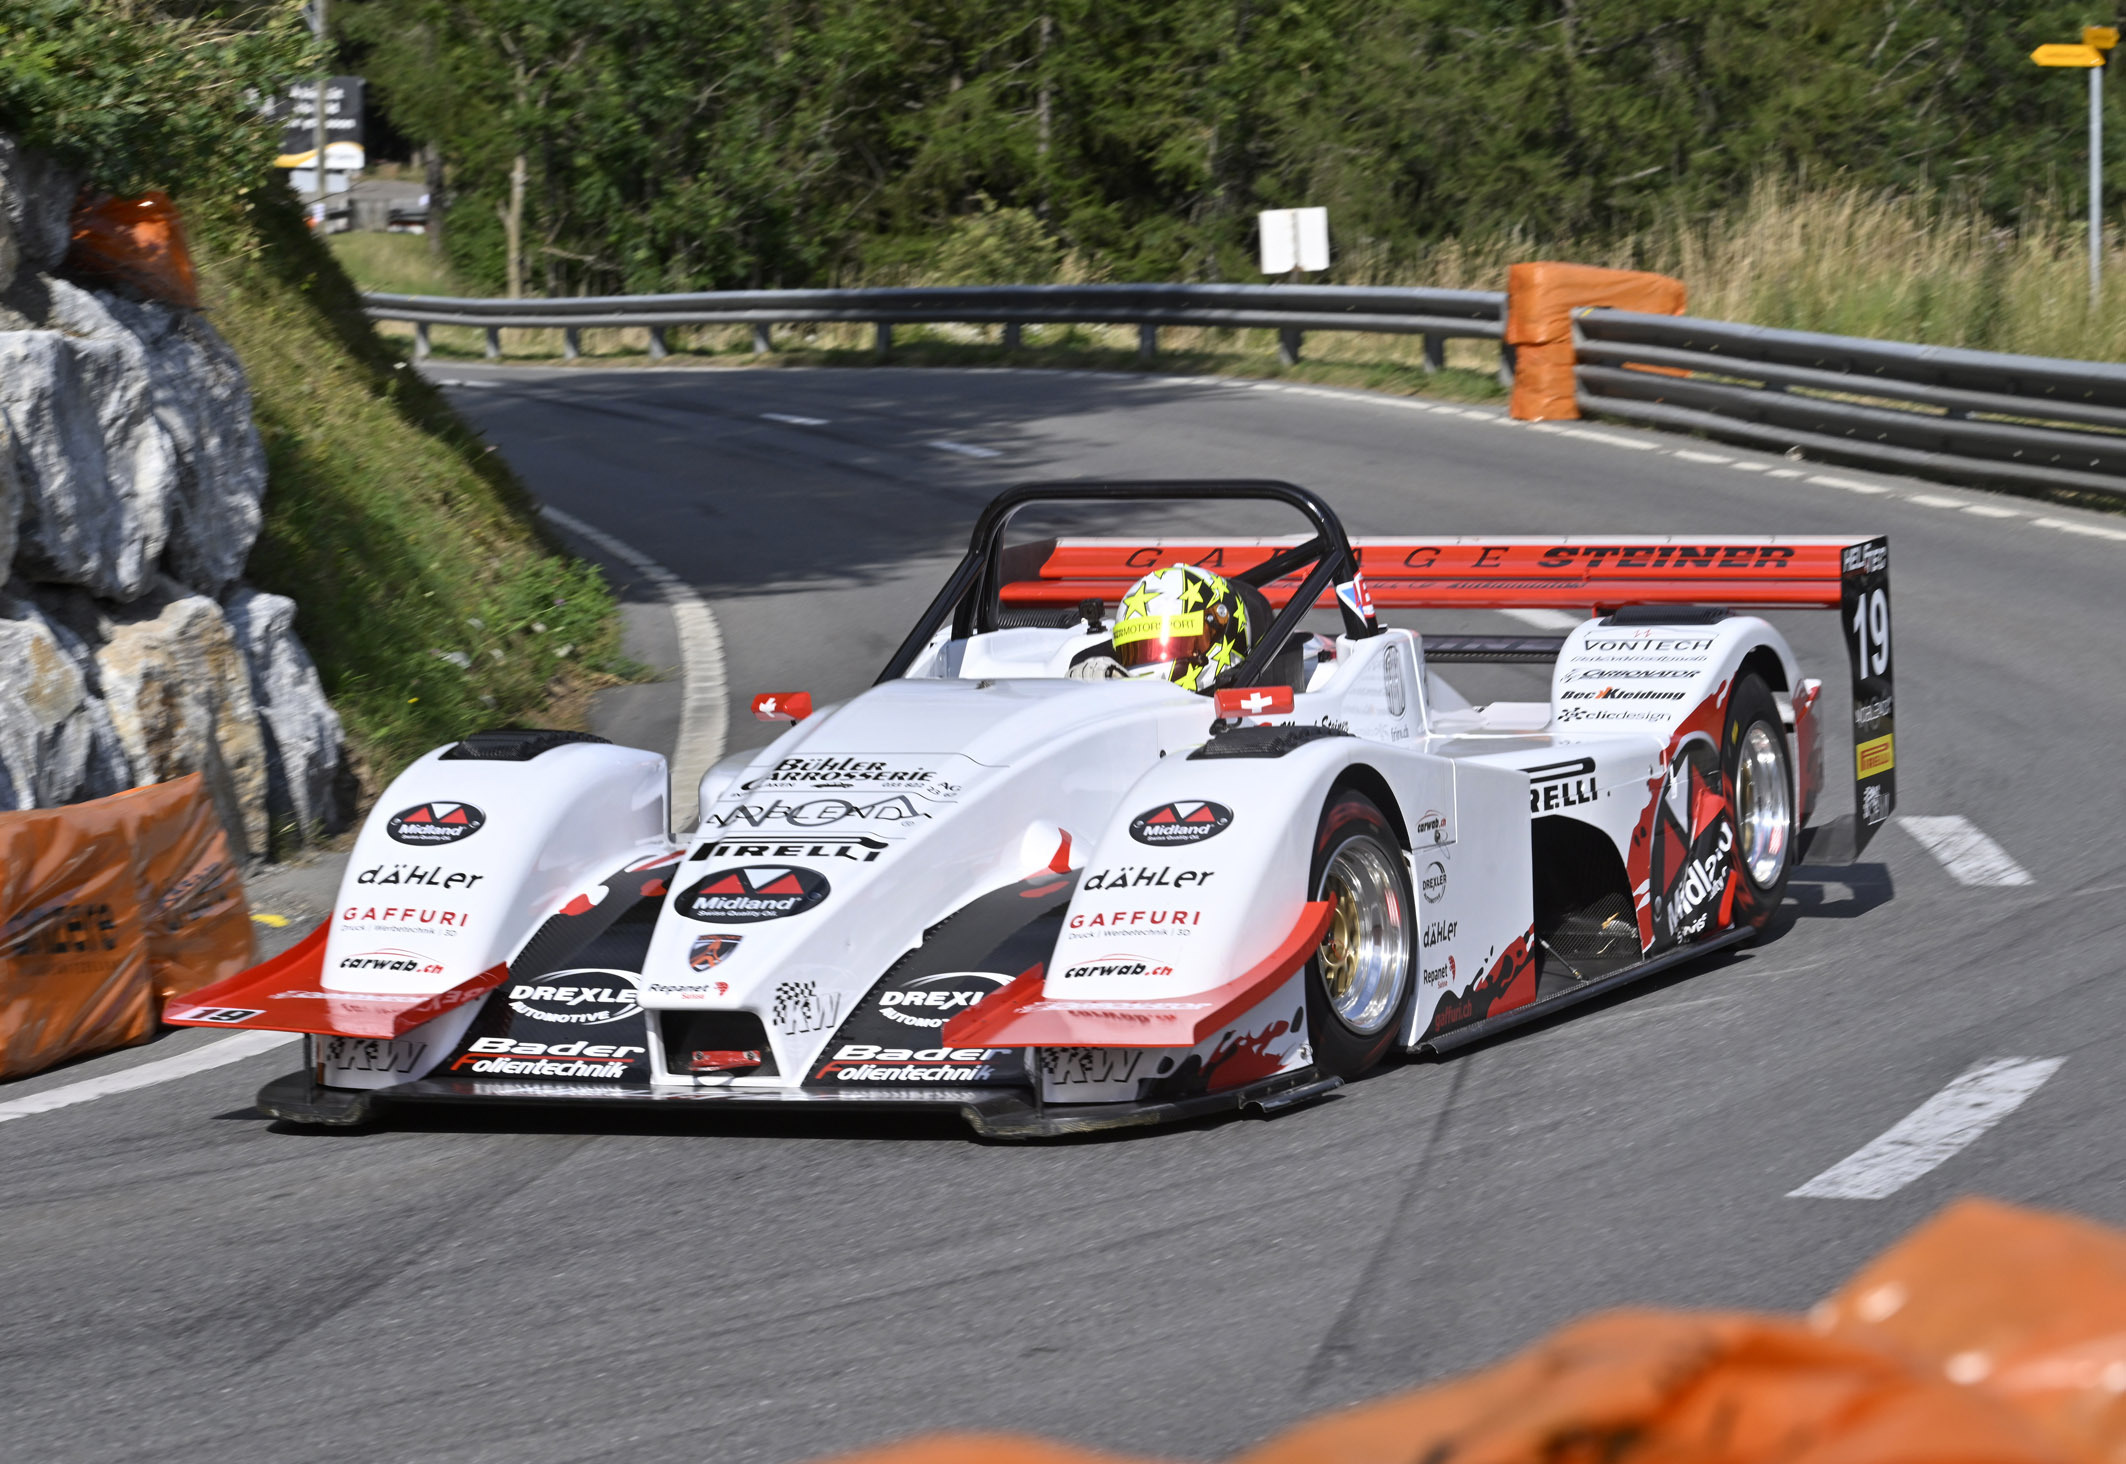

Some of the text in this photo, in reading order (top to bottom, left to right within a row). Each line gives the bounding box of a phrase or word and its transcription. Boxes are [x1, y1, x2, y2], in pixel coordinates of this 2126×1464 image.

[1125, 546, 1796, 570] GAGE STEINER
[1853, 587, 1889, 681] 19
[1585, 639, 1714, 651] VONTECH
[1586, 709, 1672, 722] clicdesign
[397, 824, 463, 836] Midland
[1142, 823, 1211, 836] Midland
[1417, 817, 1447, 833] carwab.ch
[689, 836, 889, 862] PIRELLI
[1422, 874, 1447, 892] DREXLER
[691, 896, 797, 910] Midland
[343, 906, 468, 927] GAFFURI
[727, 910, 760, 918] Quality
[1069, 911, 1201, 929] GAFFURI
[1068, 928, 1191, 940] Druck Werbetechnik 3D
[340, 958, 444, 974] carwab.ch
[1065, 962, 1174, 979] carwab.ch
[1423, 963, 1448, 987] Repanet
[508, 985, 639, 1006] DREXLE
[648, 983, 709, 995] Repanet
[188, 1008, 257, 1021] 19
[508, 1000, 610, 1023] AUTOMOTIVE
[879, 1006, 950, 1028] AUTOMO
[1435, 1000, 1473, 1033] gaffuri.ch
[338, 1038, 429, 1073] KW
[468, 1037, 645, 1057] Bader
[833, 1044, 1012, 1061] Bader
[450, 1054, 629, 1079] Folientechnik
[815, 1061, 997, 1080] Folientechnik
[1053, 1048, 1144, 1084] KW
